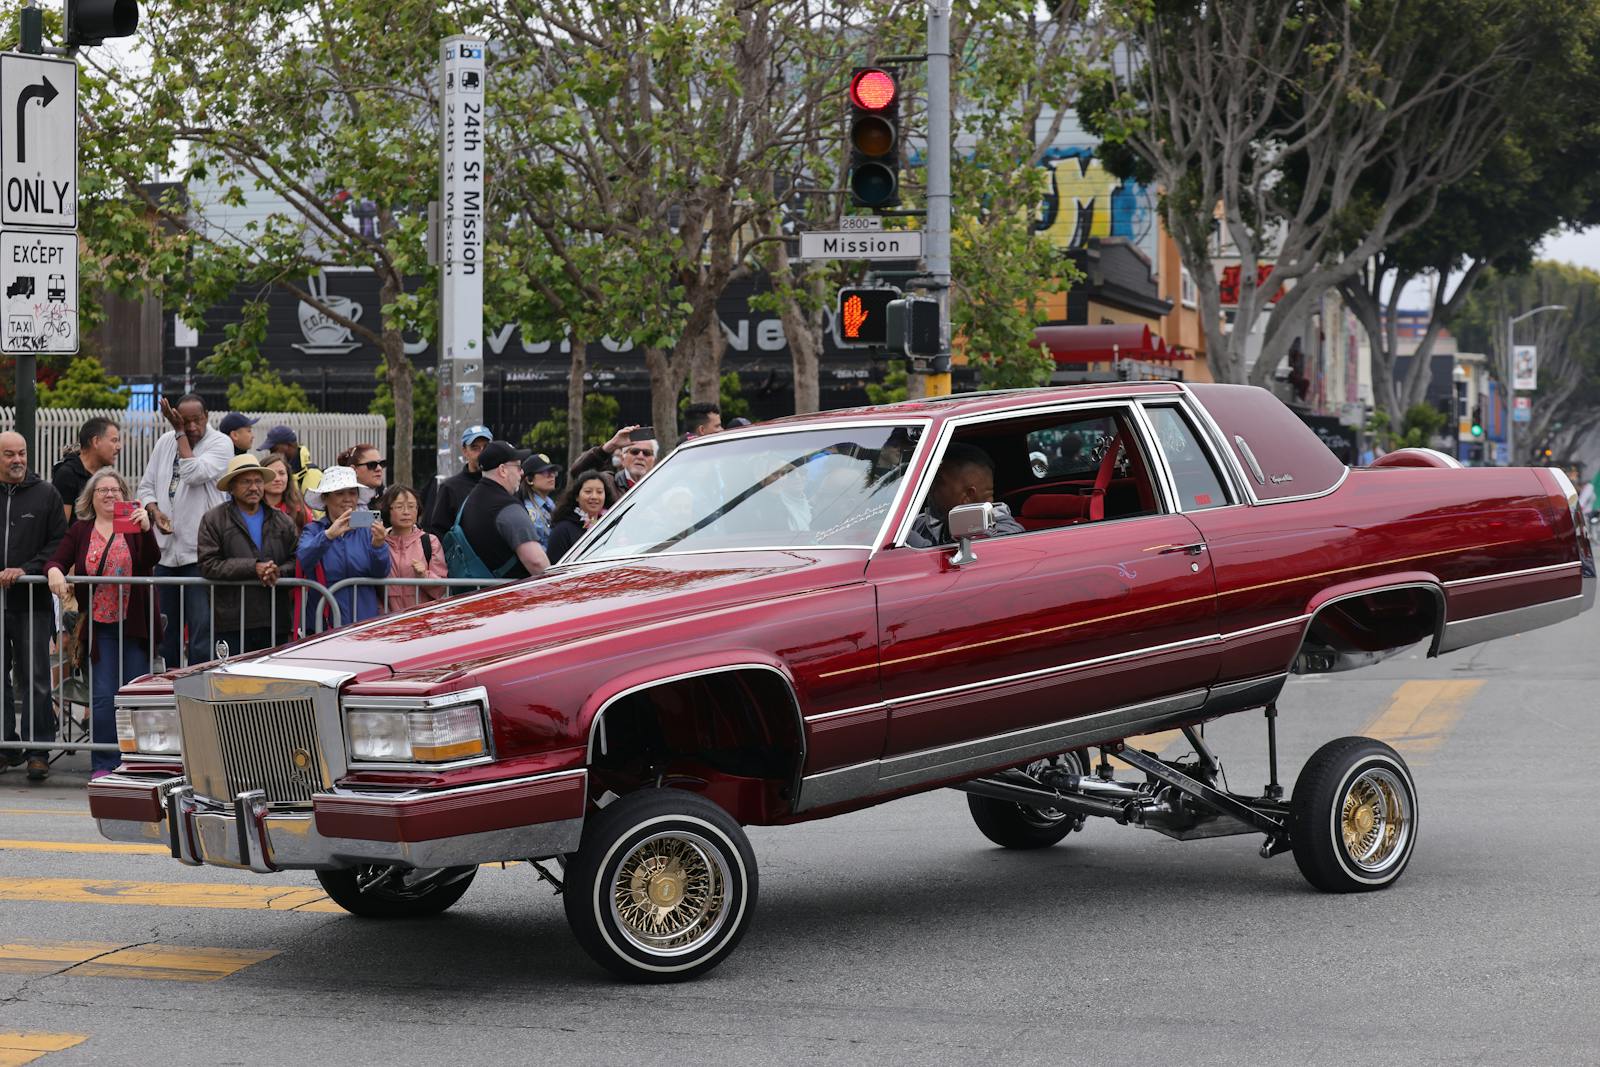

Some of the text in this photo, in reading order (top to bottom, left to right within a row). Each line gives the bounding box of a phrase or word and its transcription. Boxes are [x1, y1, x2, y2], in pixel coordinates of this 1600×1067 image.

[7, 177, 70, 215] ONLY
[446, 103, 455, 276] 24th St Mission
[463, 102, 481, 275] 24th St Mission
[842, 219, 869, 229] 2800
[13, 245, 64, 264] EXCEPT
[823, 237, 900, 253] Mission
[10, 321, 33, 333] TAXI
